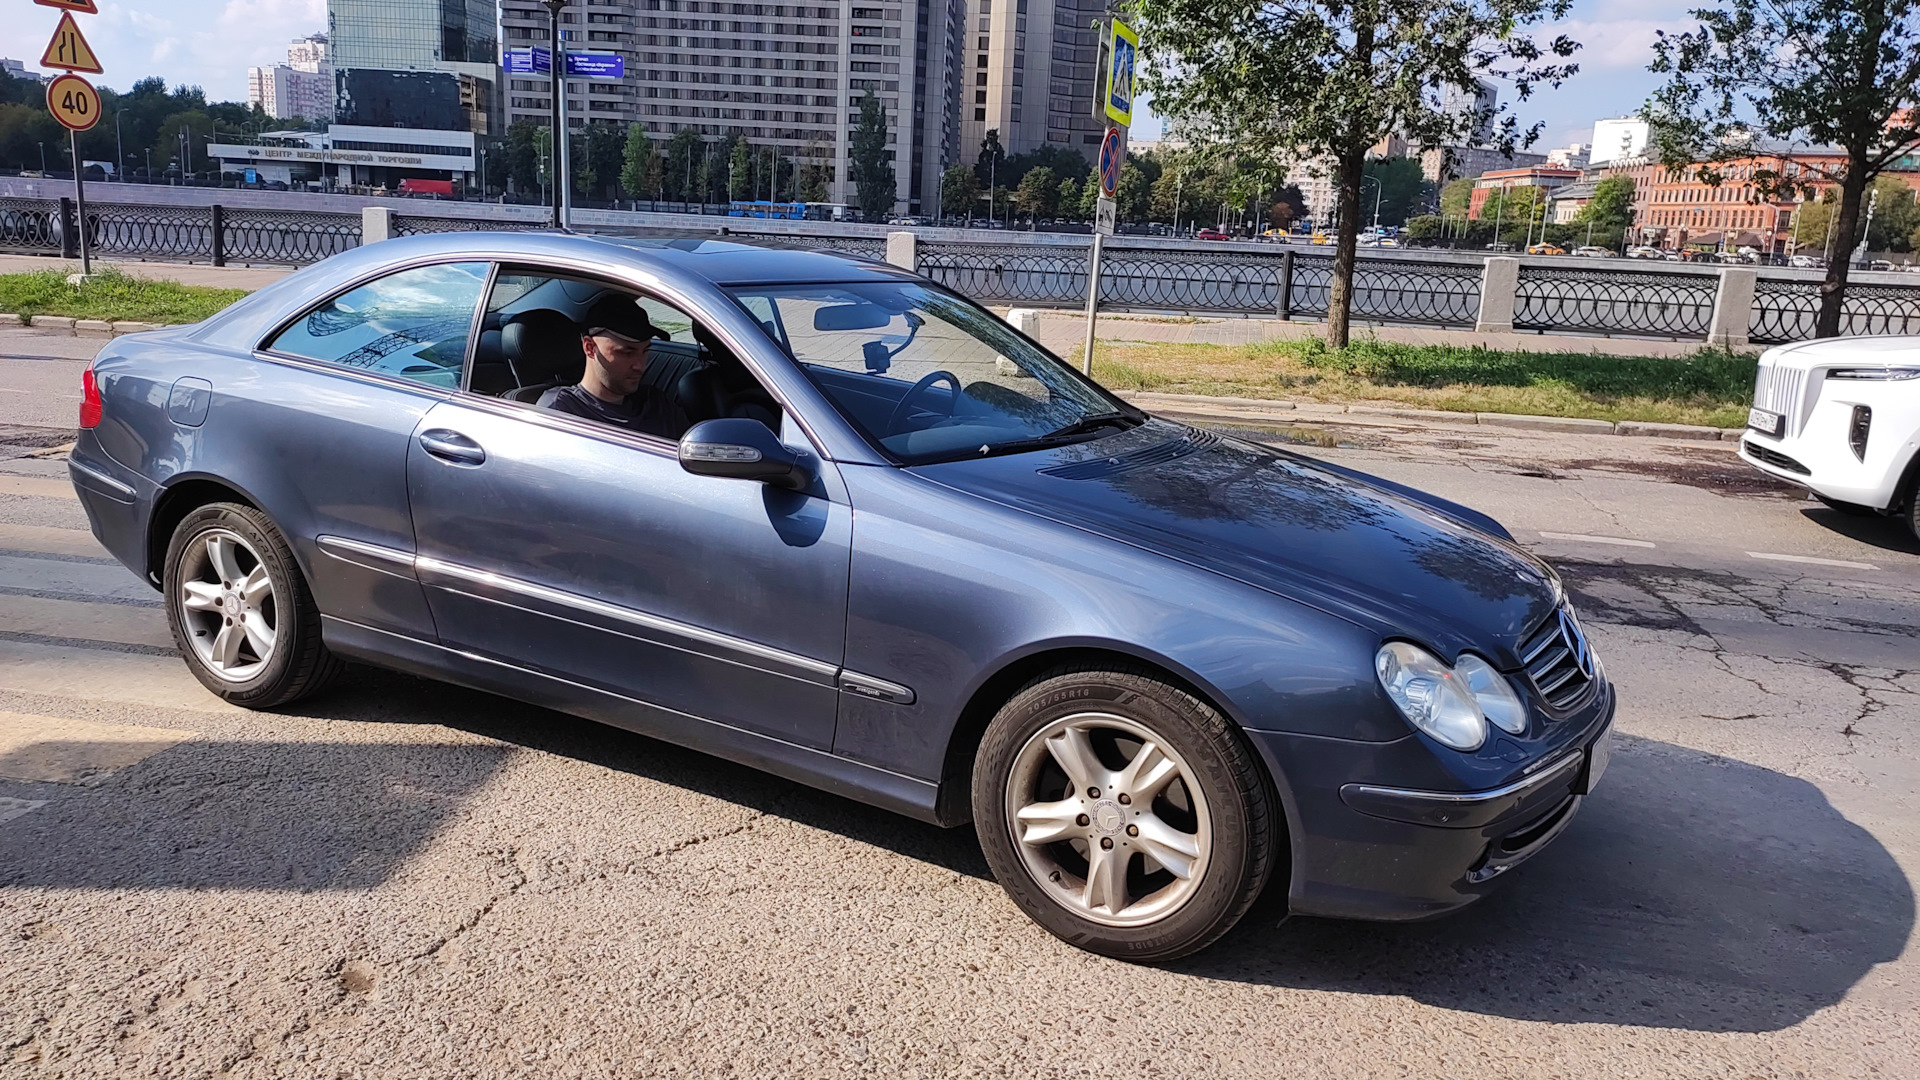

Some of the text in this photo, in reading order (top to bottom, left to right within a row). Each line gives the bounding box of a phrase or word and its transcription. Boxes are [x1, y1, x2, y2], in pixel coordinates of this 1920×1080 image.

[62, 90, 88, 115] 40
[297, 151, 373, 162] МЕЖДУНАРОДНОЙ
[378, 155, 422, 165] ТОРГОВЛИ
[249, 530, 287, 594] ATREZZO
[1027, 688, 1090, 714] 205/55R16
[983, 818, 1038, 910] ATREZZO
[1127, 934, 1175, 950] OUTSIDE
